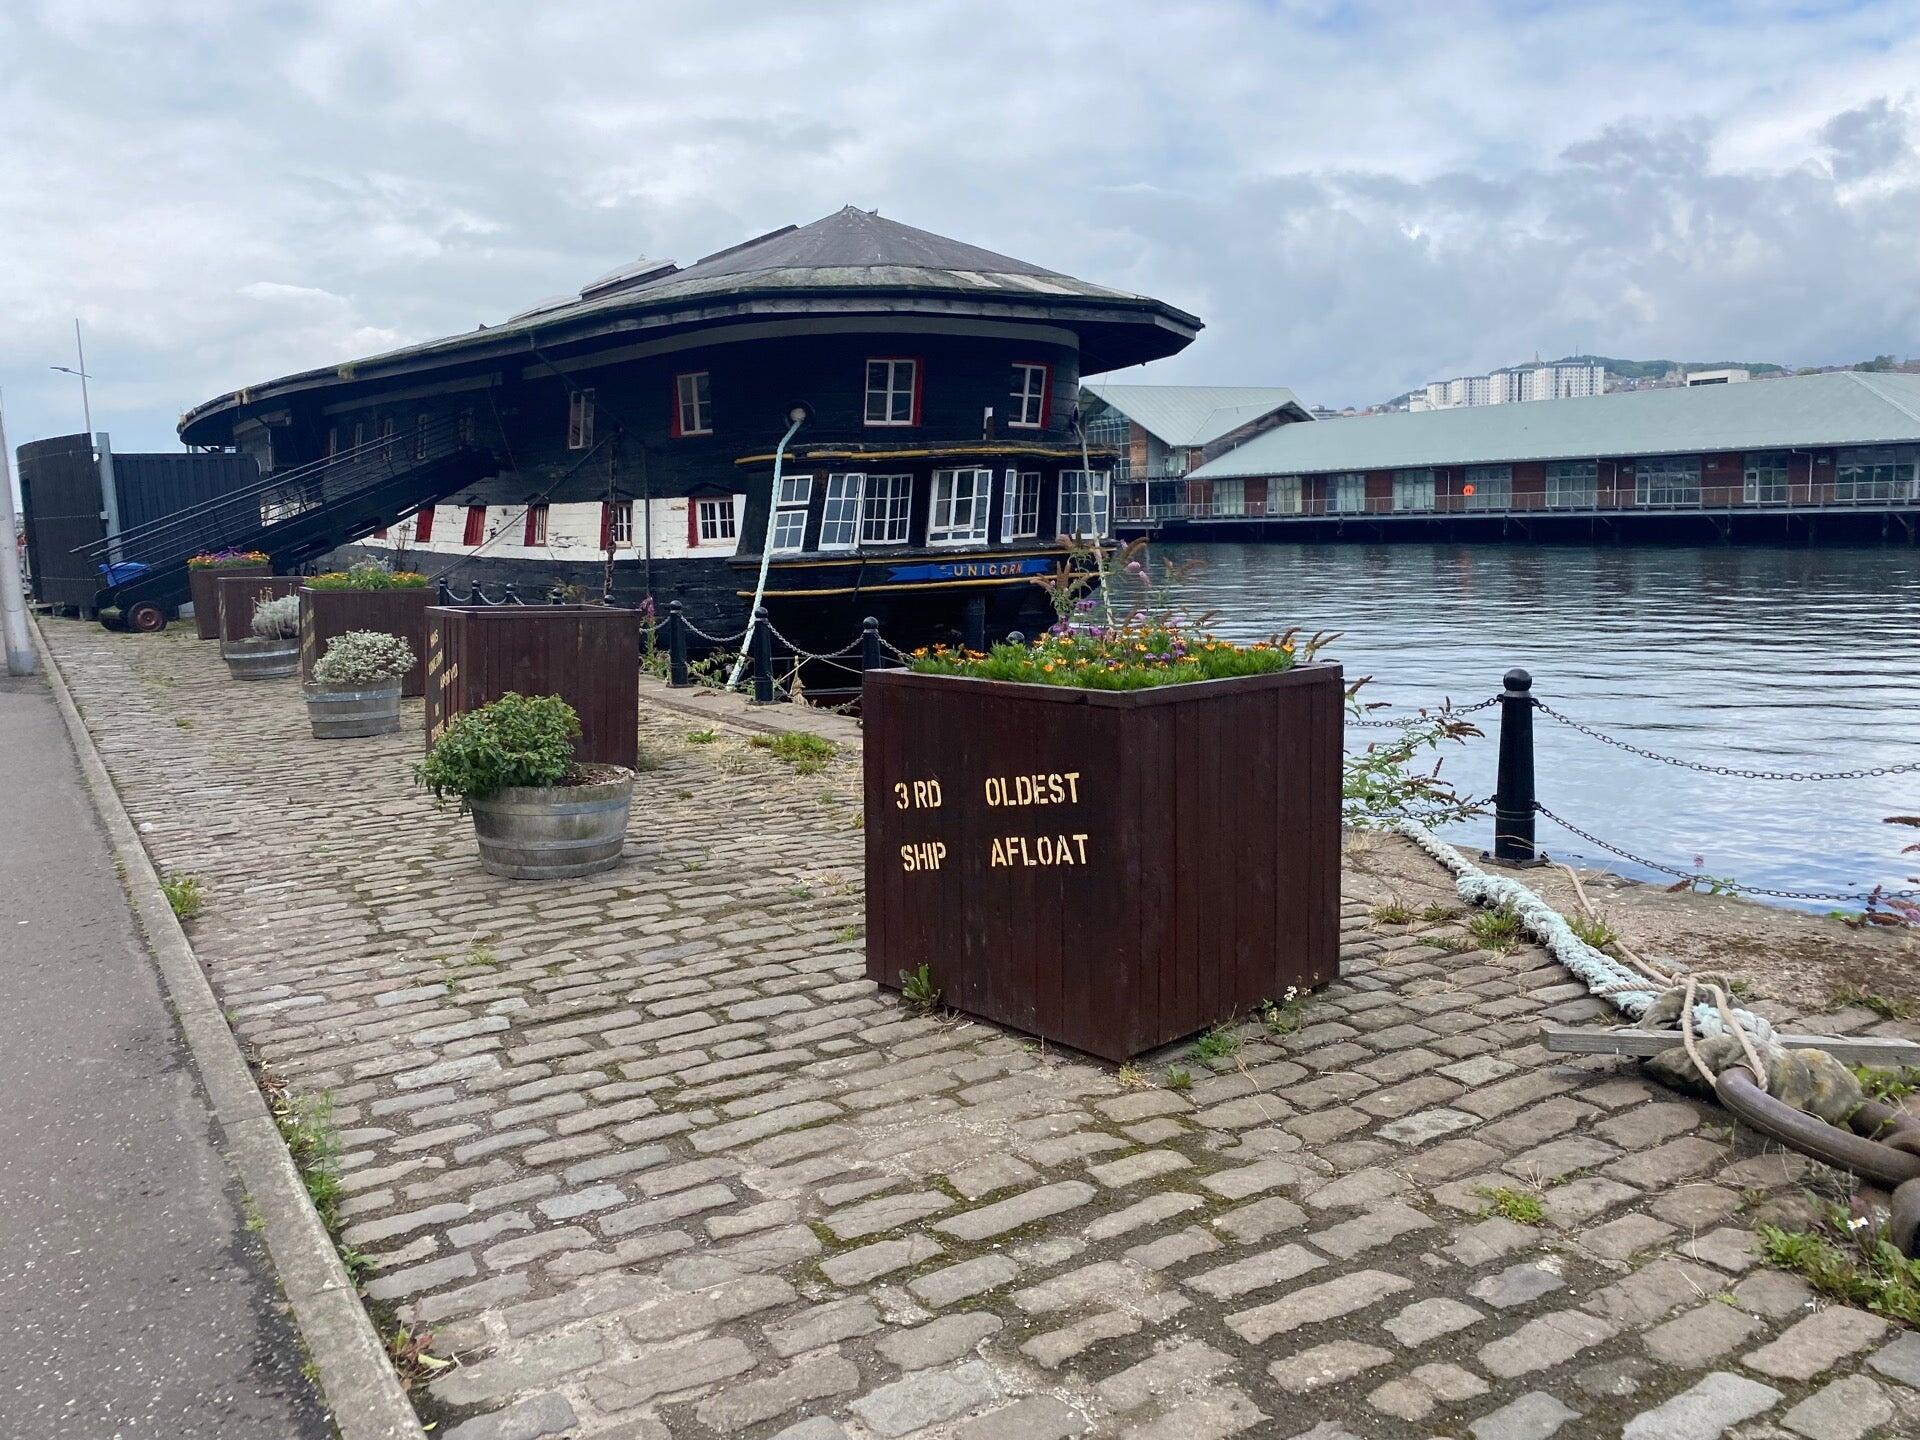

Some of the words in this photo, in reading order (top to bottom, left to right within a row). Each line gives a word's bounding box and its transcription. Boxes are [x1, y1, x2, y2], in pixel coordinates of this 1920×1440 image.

[953, 563, 1023, 577] UNICORN
[985, 772, 1080, 807] OLDEST
[900, 841, 947, 872] SHIP
[991, 833, 1089, 867] AFLOAT
